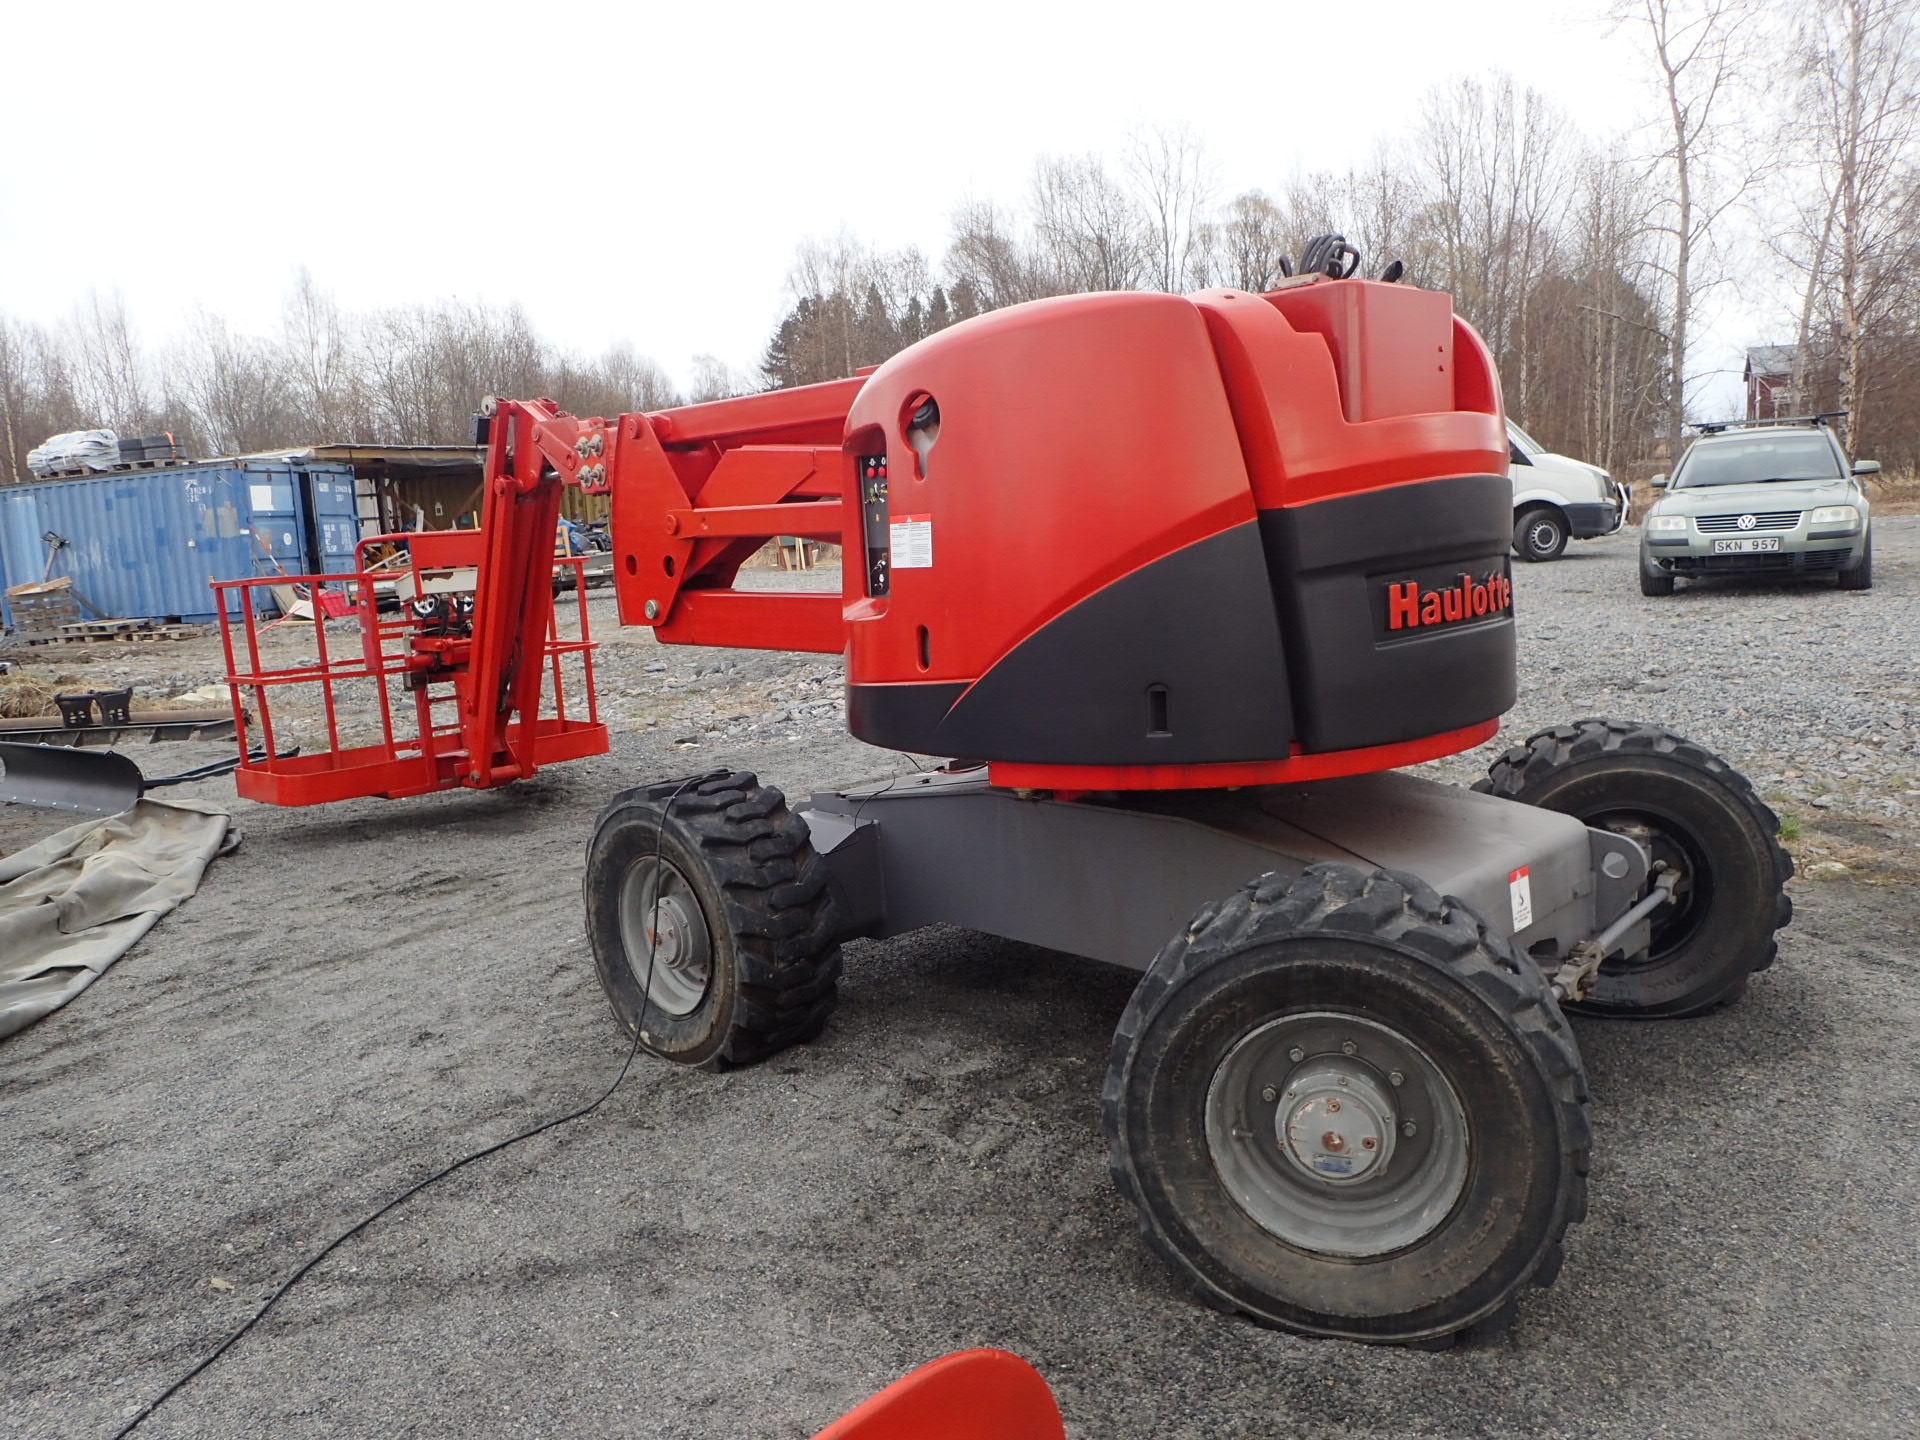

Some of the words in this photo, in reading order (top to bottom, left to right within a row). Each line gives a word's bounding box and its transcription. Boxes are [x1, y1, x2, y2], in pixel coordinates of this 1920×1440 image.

[1717, 541, 1742, 551] SKN
[1752, 540, 1777, 550] 957
[1389, 573, 1510, 630] Haulotte
